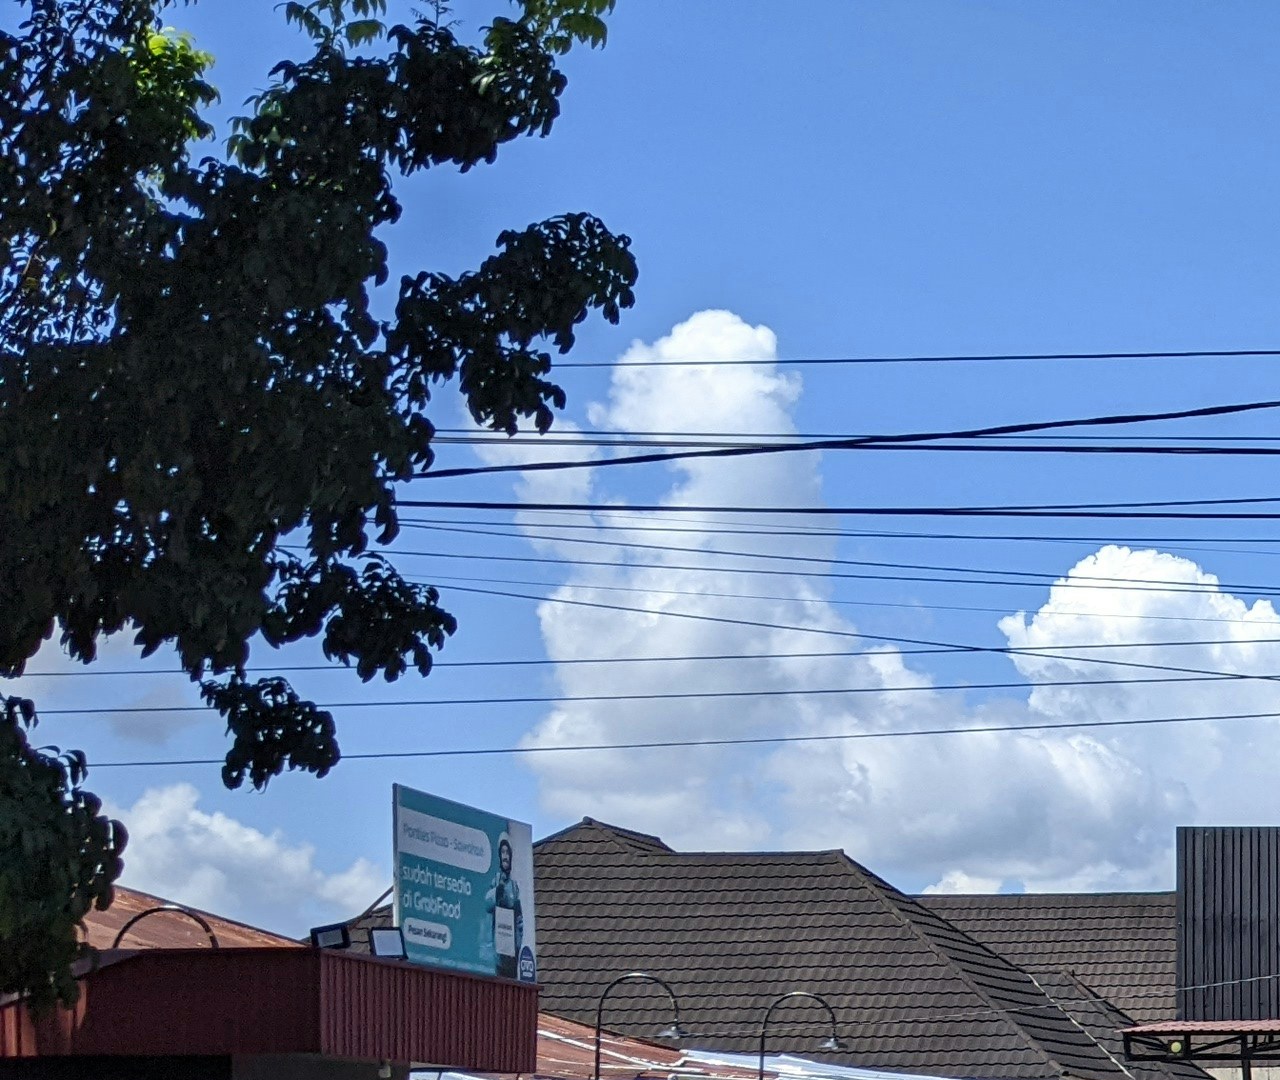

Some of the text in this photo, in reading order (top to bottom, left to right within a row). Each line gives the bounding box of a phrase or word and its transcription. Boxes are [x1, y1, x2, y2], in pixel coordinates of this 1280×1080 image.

[402, 864, 472, 896] sudah tersedia
[403, 890, 461, 919] di GrabFood
